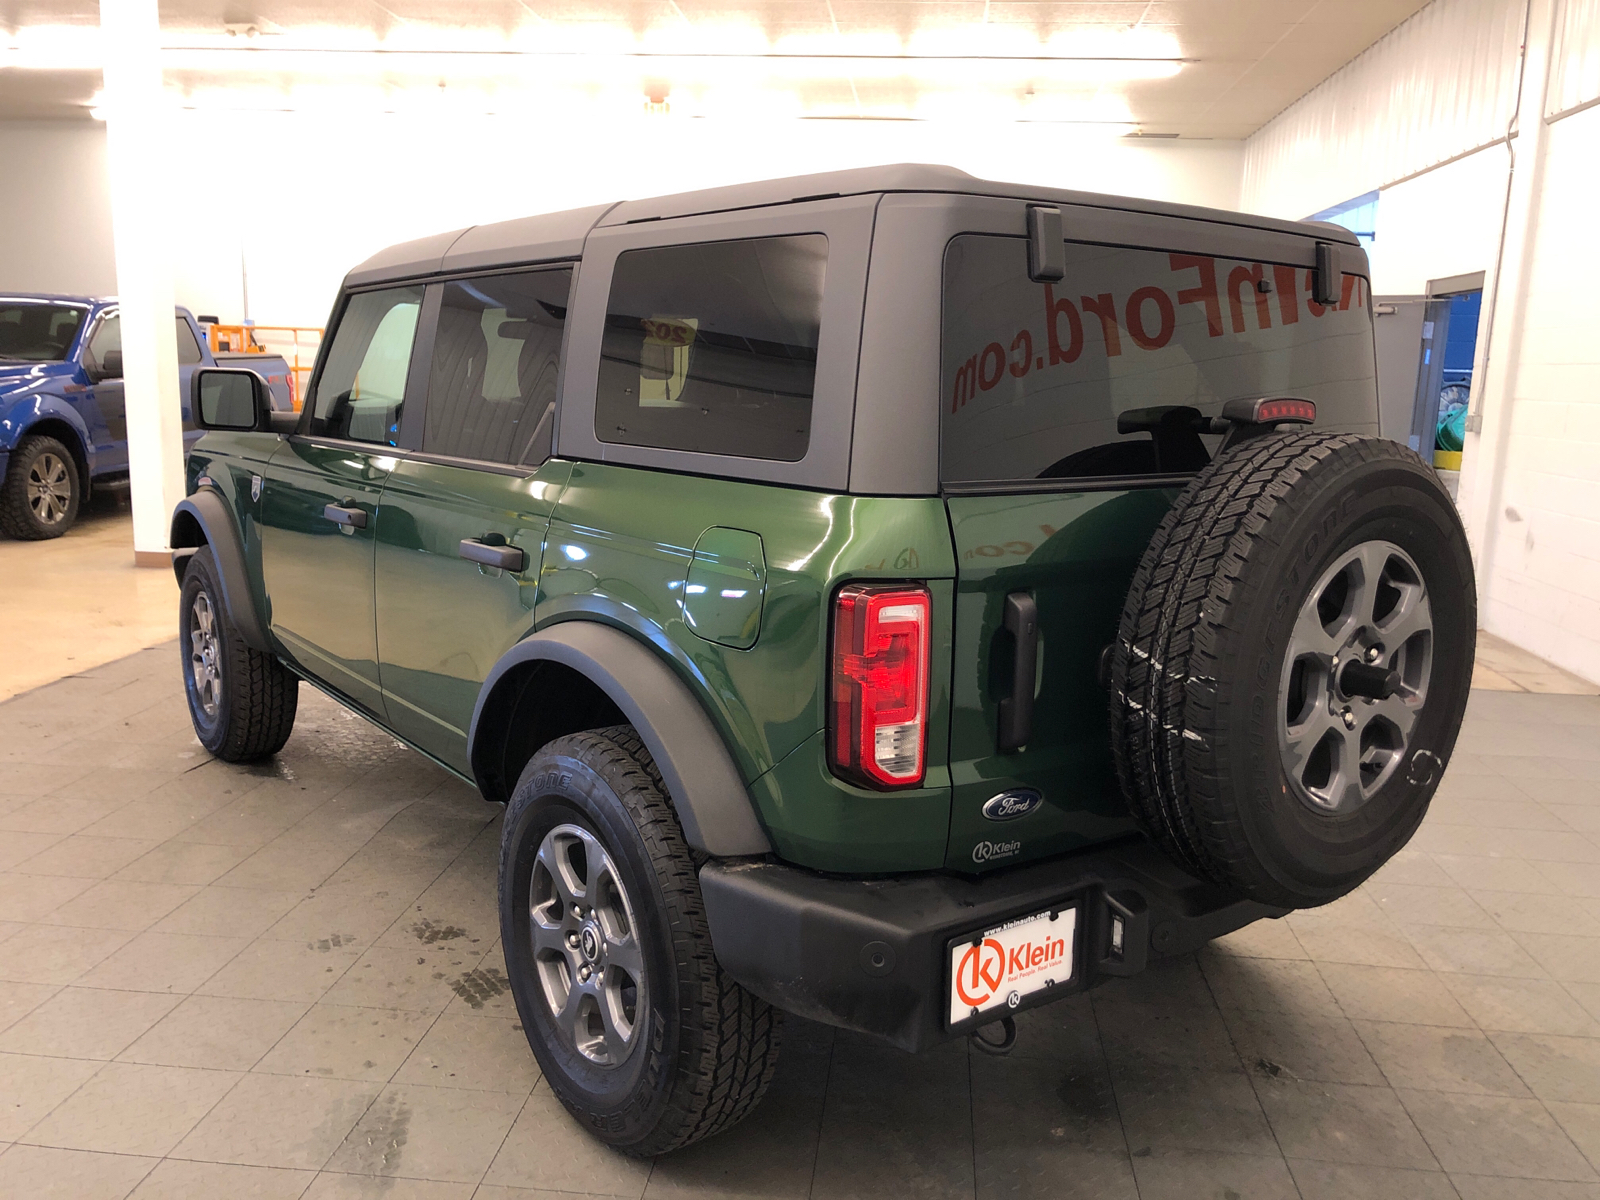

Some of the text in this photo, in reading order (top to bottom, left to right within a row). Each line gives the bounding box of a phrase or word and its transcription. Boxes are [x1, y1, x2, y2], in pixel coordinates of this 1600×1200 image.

[998, 796, 1031, 816] Ford
[992, 840, 1021, 855] Klein
[983, 910, 1051, 937] www.kleinauto.com
[1008, 935, 1065, 975] Klein
[1007, 974, 1019, 983] Real
[1037, 963, 1049, 972] Real
